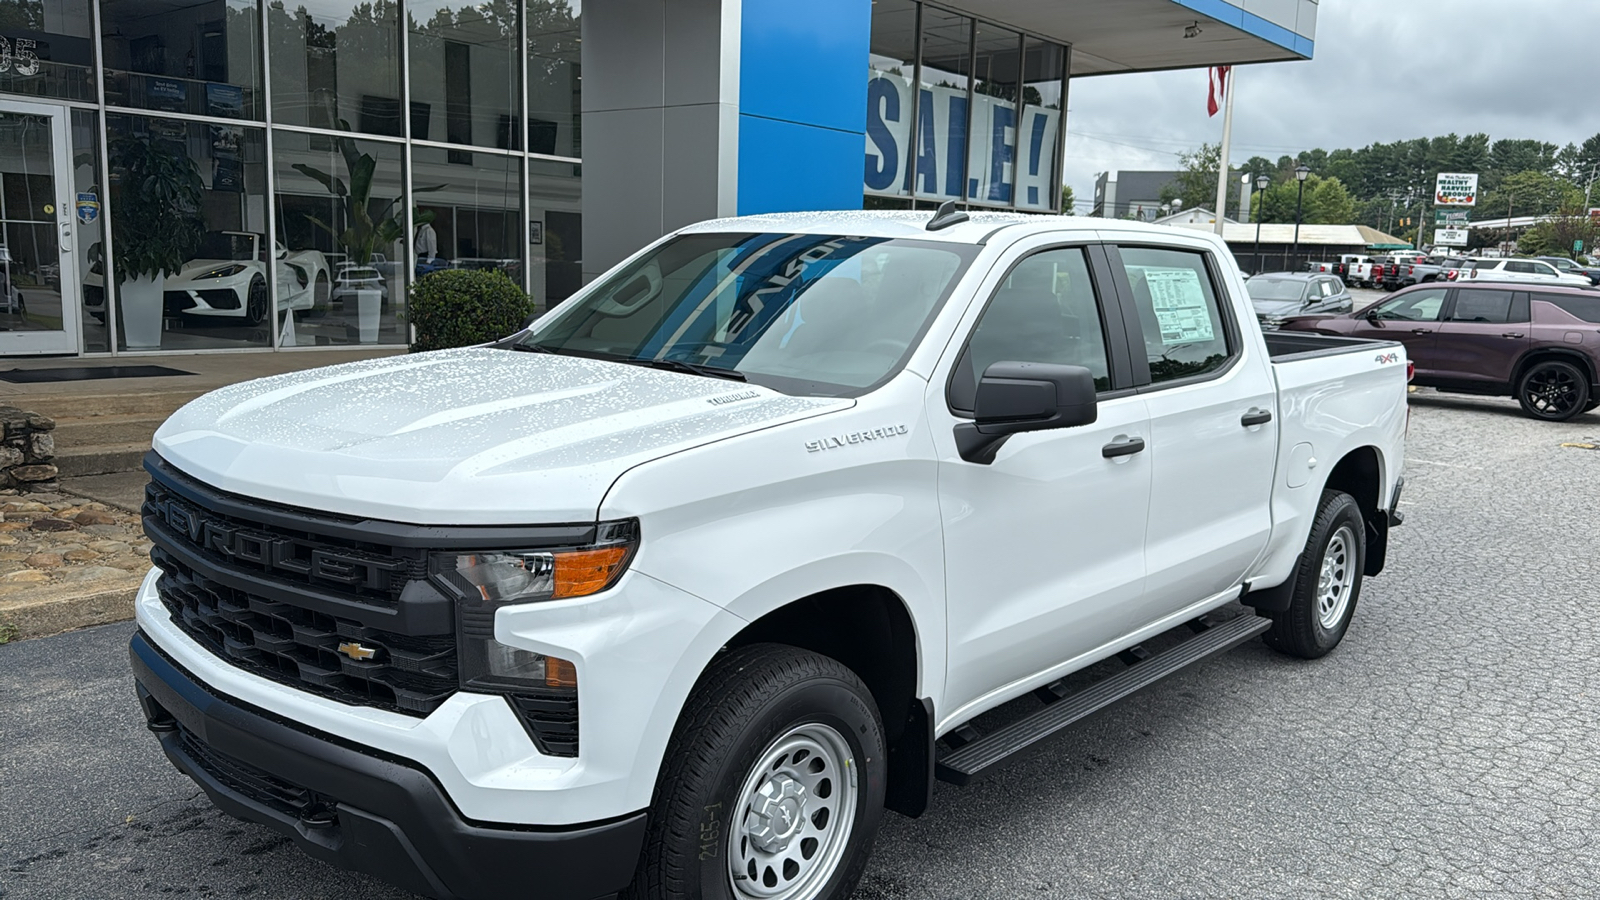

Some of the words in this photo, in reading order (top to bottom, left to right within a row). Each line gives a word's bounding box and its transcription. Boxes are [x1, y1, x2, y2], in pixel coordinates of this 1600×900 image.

[863, 77, 1049, 205] SALE!
[804, 424, 909, 453] SILVERADO
[146, 483, 407, 590] CHEVROLET
